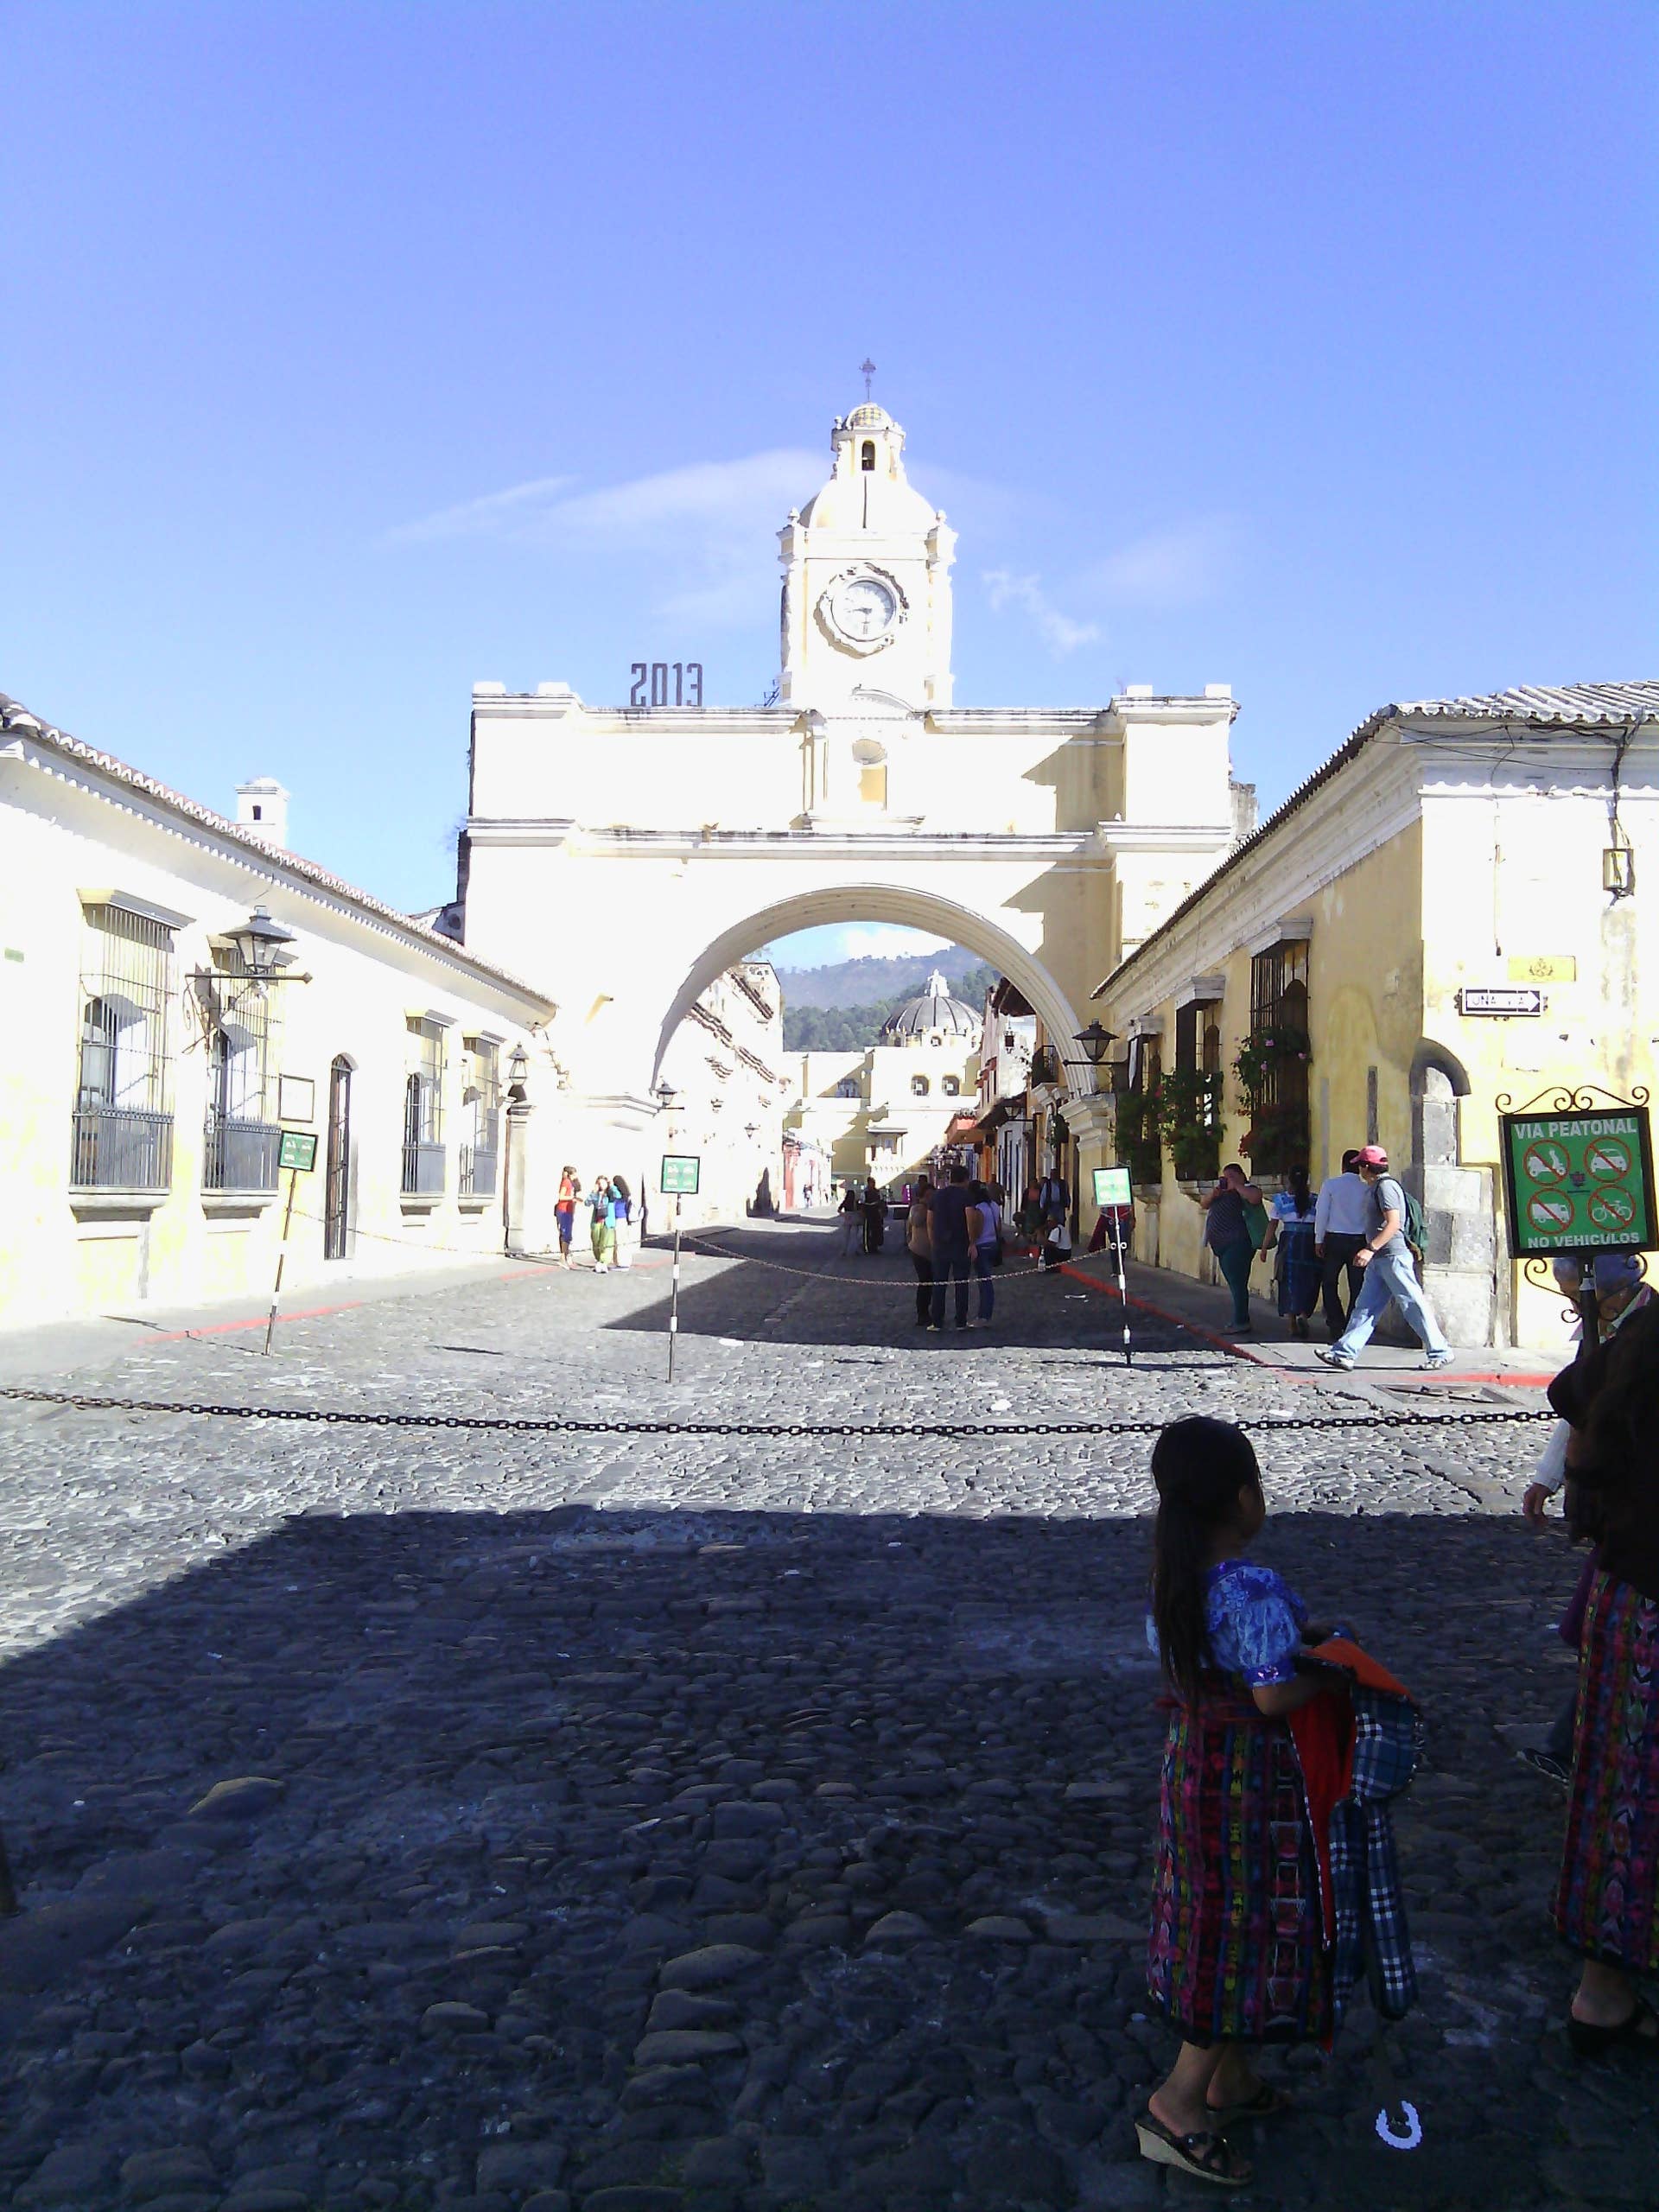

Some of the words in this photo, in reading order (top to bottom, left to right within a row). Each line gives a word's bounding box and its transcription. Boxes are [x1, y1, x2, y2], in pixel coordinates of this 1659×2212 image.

[631, 662, 702, 707] 2013
[1514, 1123, 1545, 1139] VIA
[1548, 1117, 1638, 1137] PEATONAL
[1528, 1236, 1549, 1249] NO
[1554, 1232, 1640, 1248] VEHICULOS
